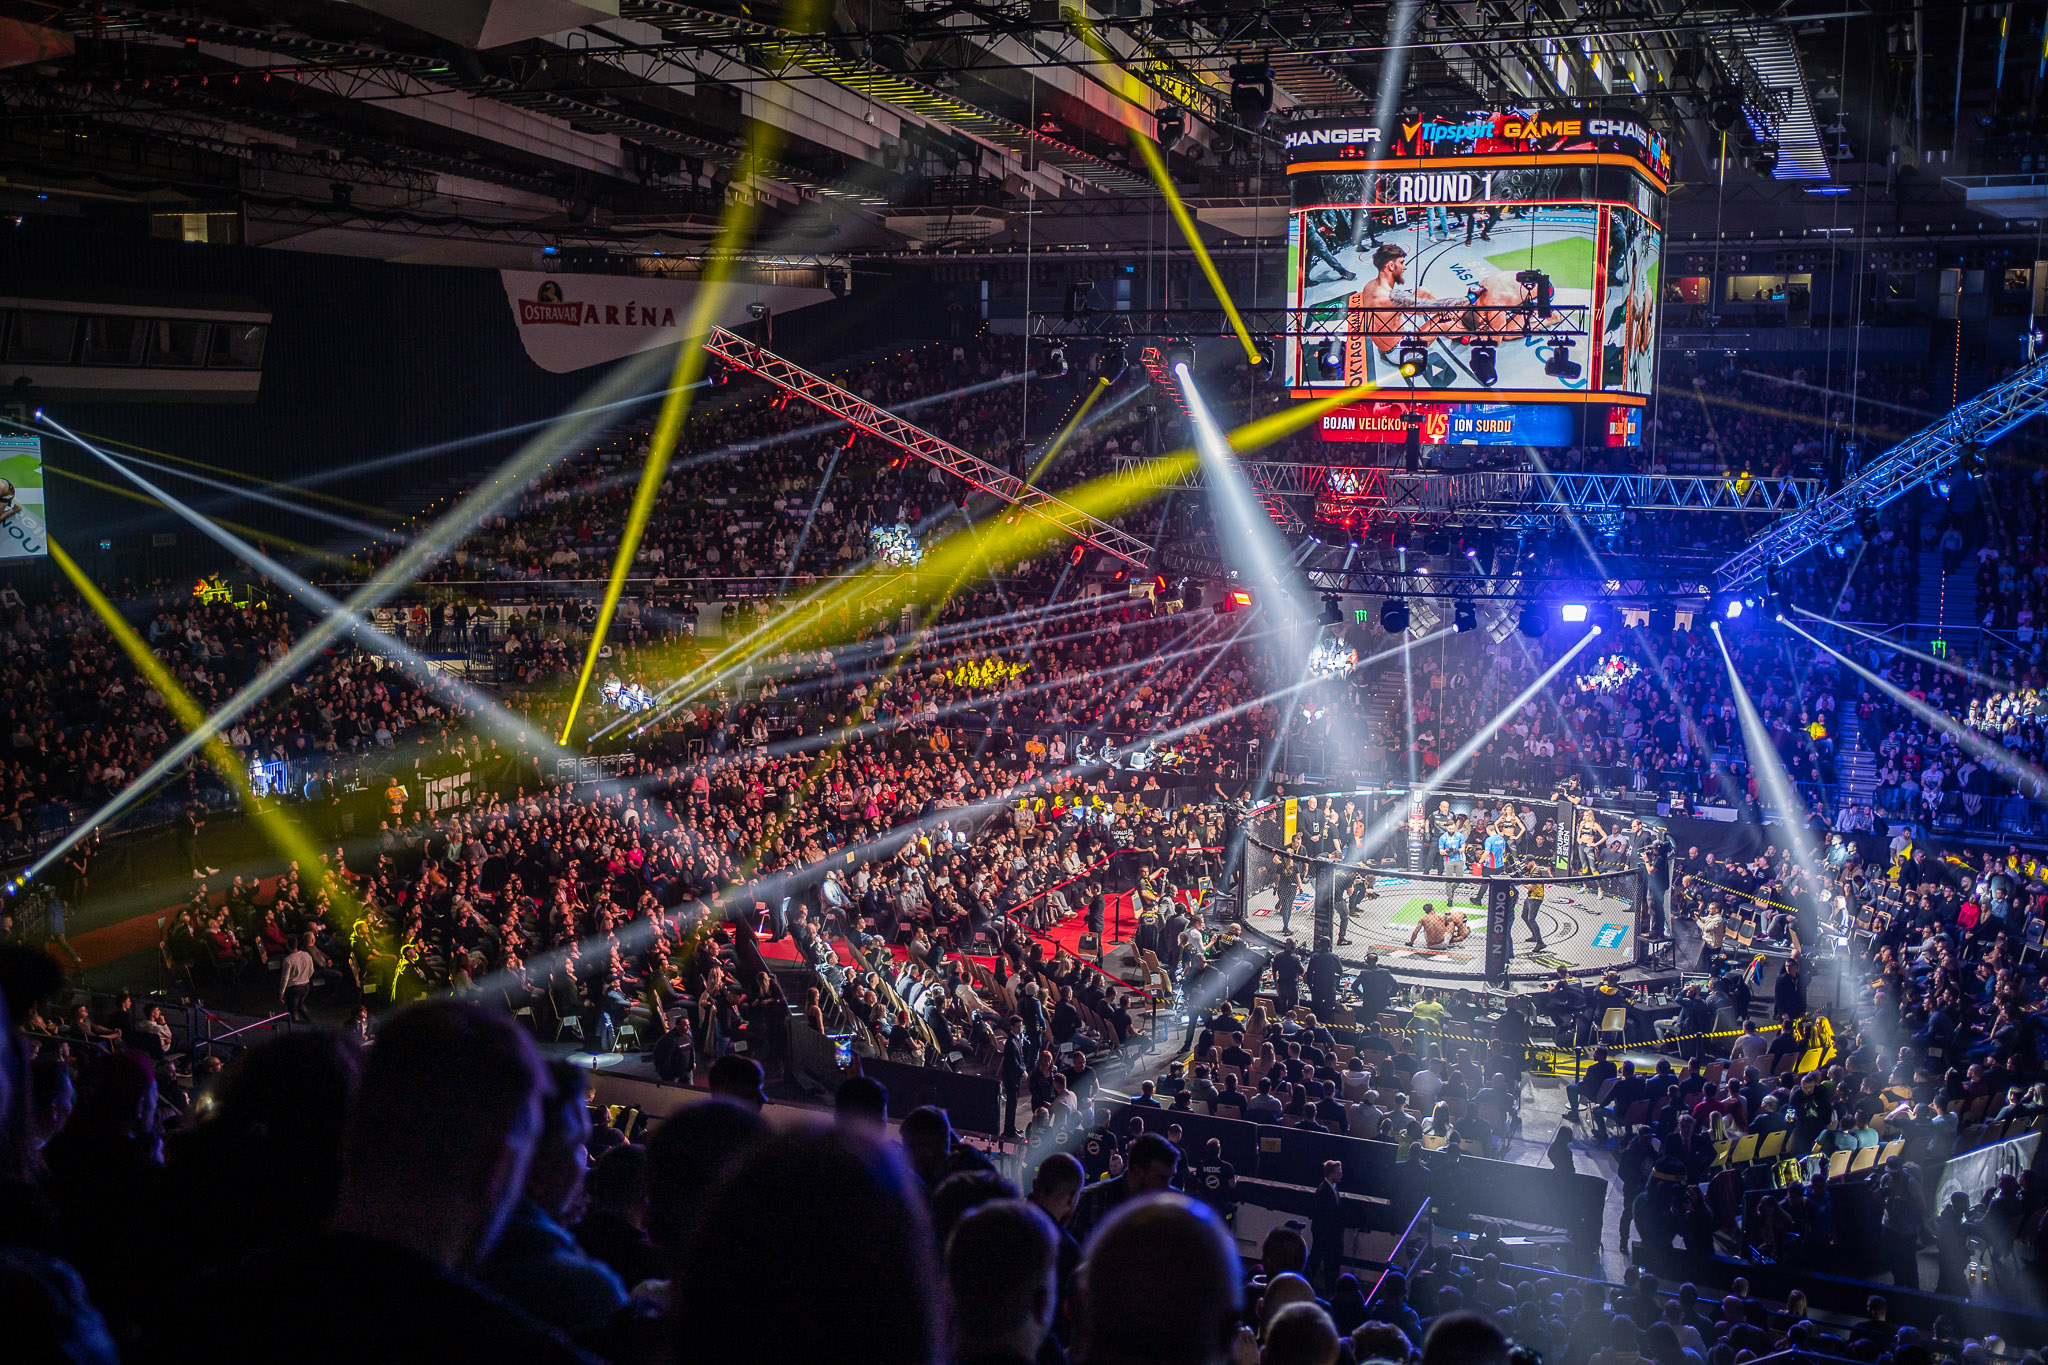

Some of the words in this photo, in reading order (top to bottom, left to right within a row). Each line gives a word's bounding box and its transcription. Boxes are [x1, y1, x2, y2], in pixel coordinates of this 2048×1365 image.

[1421, 121, 1496, 144] Tipsport
[1503, 120, 1582, 138] GAME
[1399, 174, 1473, 203] ROUND
[1481, 173, 1492, 201] 1
[524, 304, 579, 323] OSTRAVAR
[583, 300, 677, 327] ARÉNA
[1323, 416, 1355, 430] BOJAN
[1358, 416, 1419, 431] VELIČKOV
[1426, 413, 1449, 435] VS
[1454, 418, 1473, 432] ION
[1475, 419, 1512, 433] SURDU
[1556, 821, 1564, 856] SKUPINA
[1562, 830, 1570, 857] SEVEN
[1087, 1131, 1104, 1141] MEDIC
